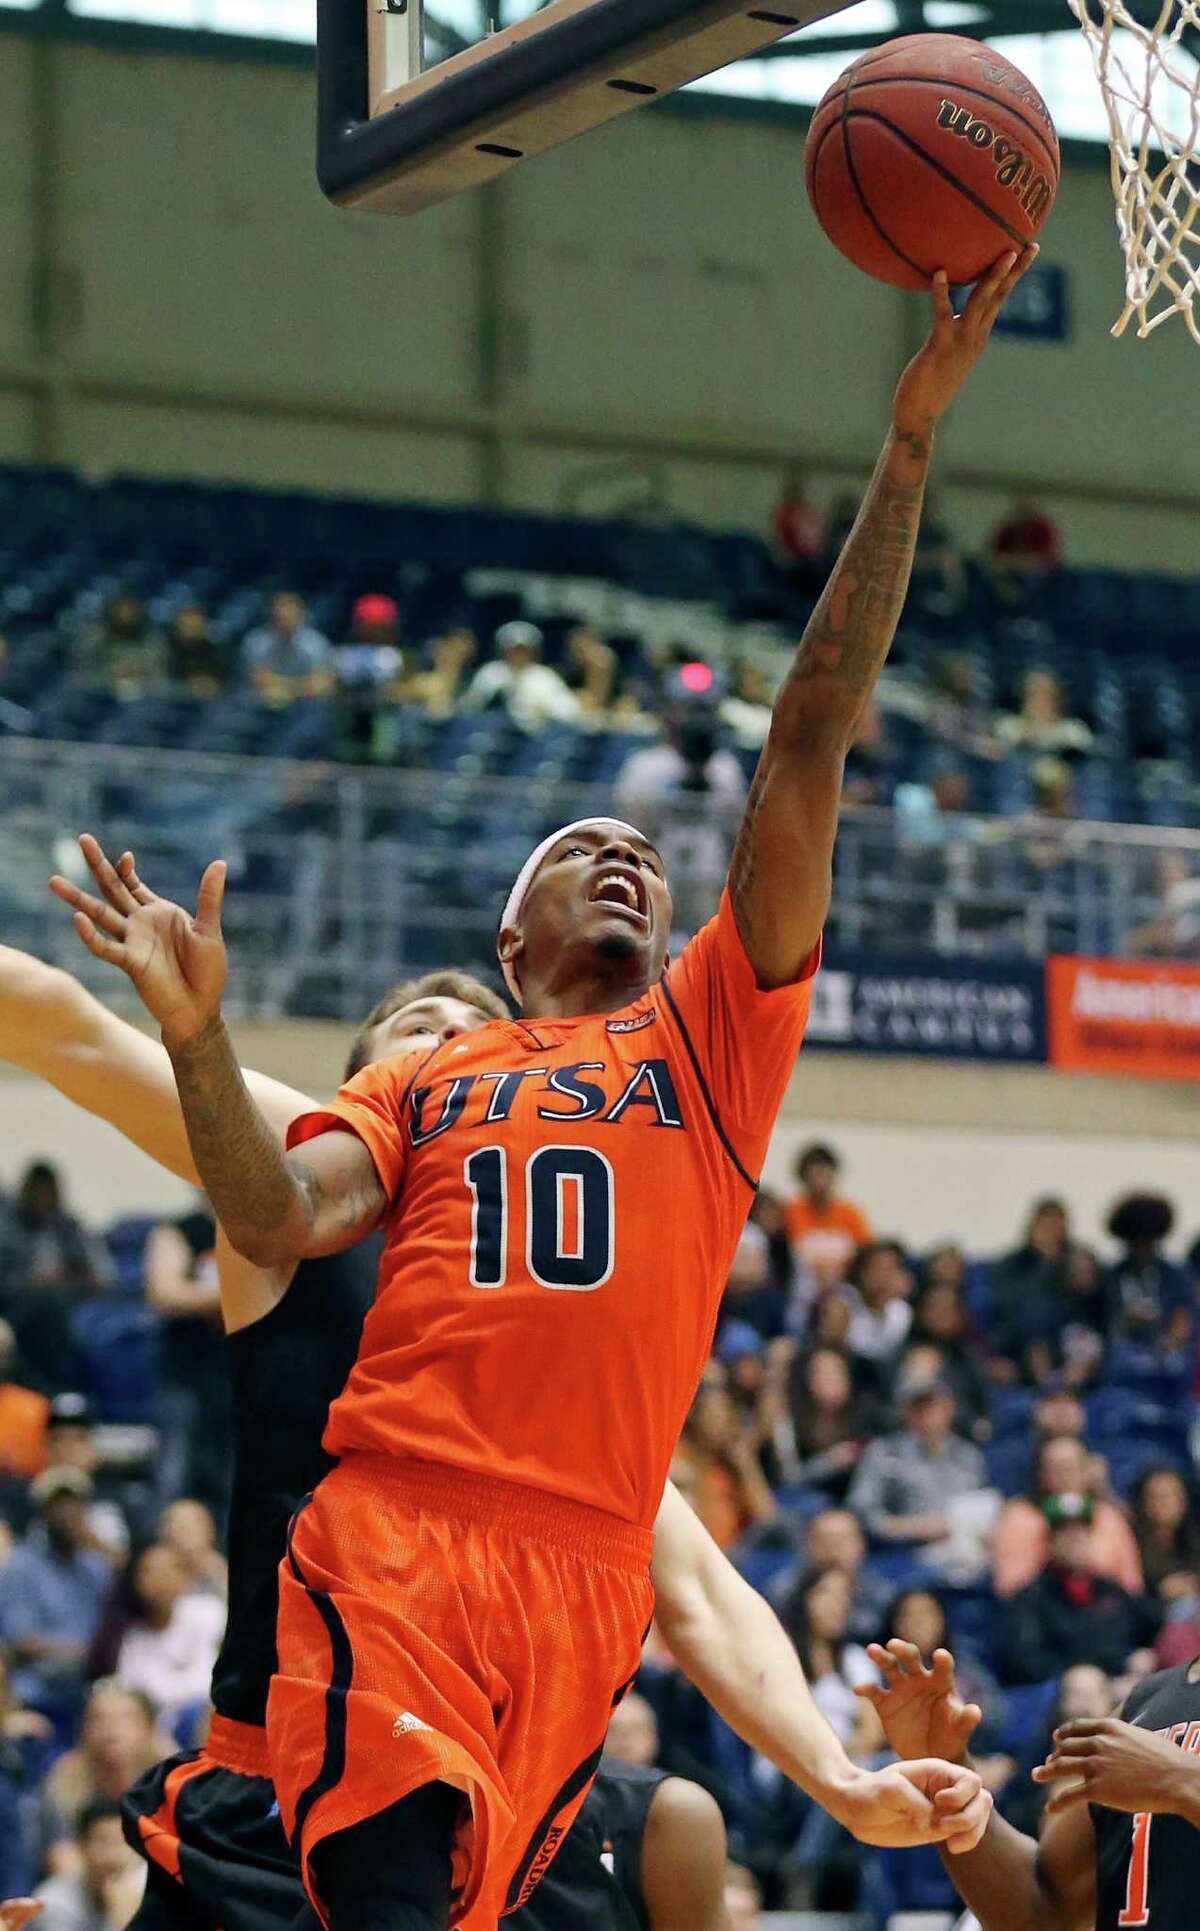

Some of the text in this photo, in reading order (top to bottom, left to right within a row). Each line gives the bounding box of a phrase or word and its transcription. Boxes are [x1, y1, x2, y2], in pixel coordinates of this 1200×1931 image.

[936, 98, 1051, 228] Wilson
[407, 1059, 686, 1146] UTSA
[463, 1144, 615, 1292] 10
